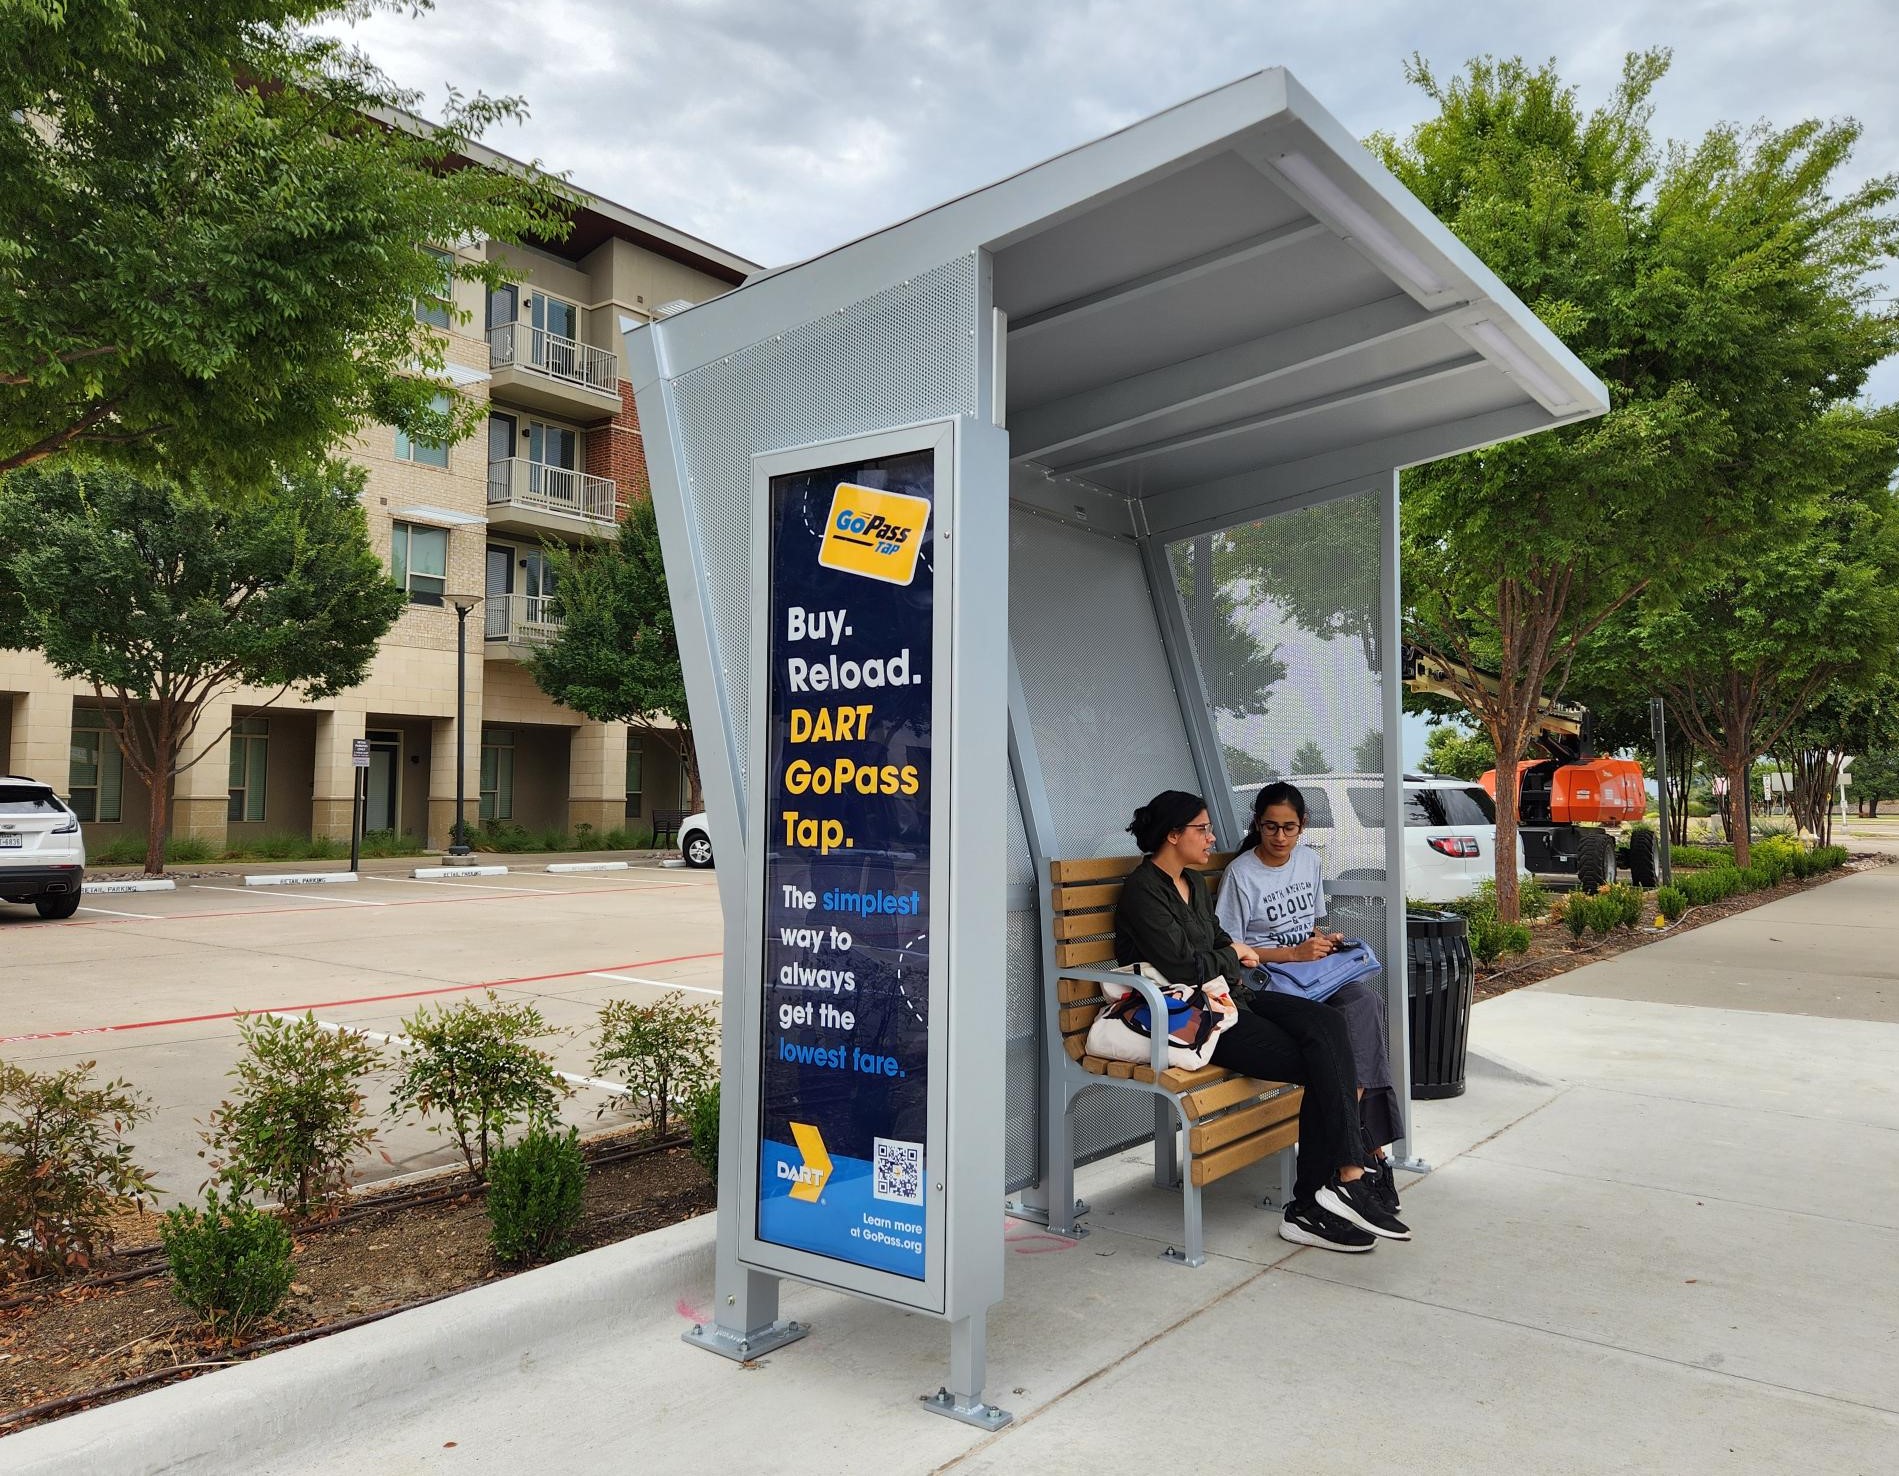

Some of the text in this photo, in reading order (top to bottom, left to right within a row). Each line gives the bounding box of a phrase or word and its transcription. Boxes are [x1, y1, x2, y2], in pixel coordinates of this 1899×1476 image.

[836, 509, 912, 544] GoPass
[788, 606, 853, 646] Buy.
[788, 648, 921, 693] Reload.
[790, 704, 873, 743] DART
[785, 758, 919, 796] GoPass
[783, 811, 854, 856] Tap.
[782, 884, 920, 918] The simplest
[780, 926, 853, 954] way to
[780, 961, 856, 995] always
[779, 1001, 856, 1031] get the
[779, 1036, 906, 1078] lowest fare.
[777, 1160, 824, 1187] DART
[863, 1212, 923, 1235] Learn more
[850, 1228, 923, 1254] at GoPass.org
